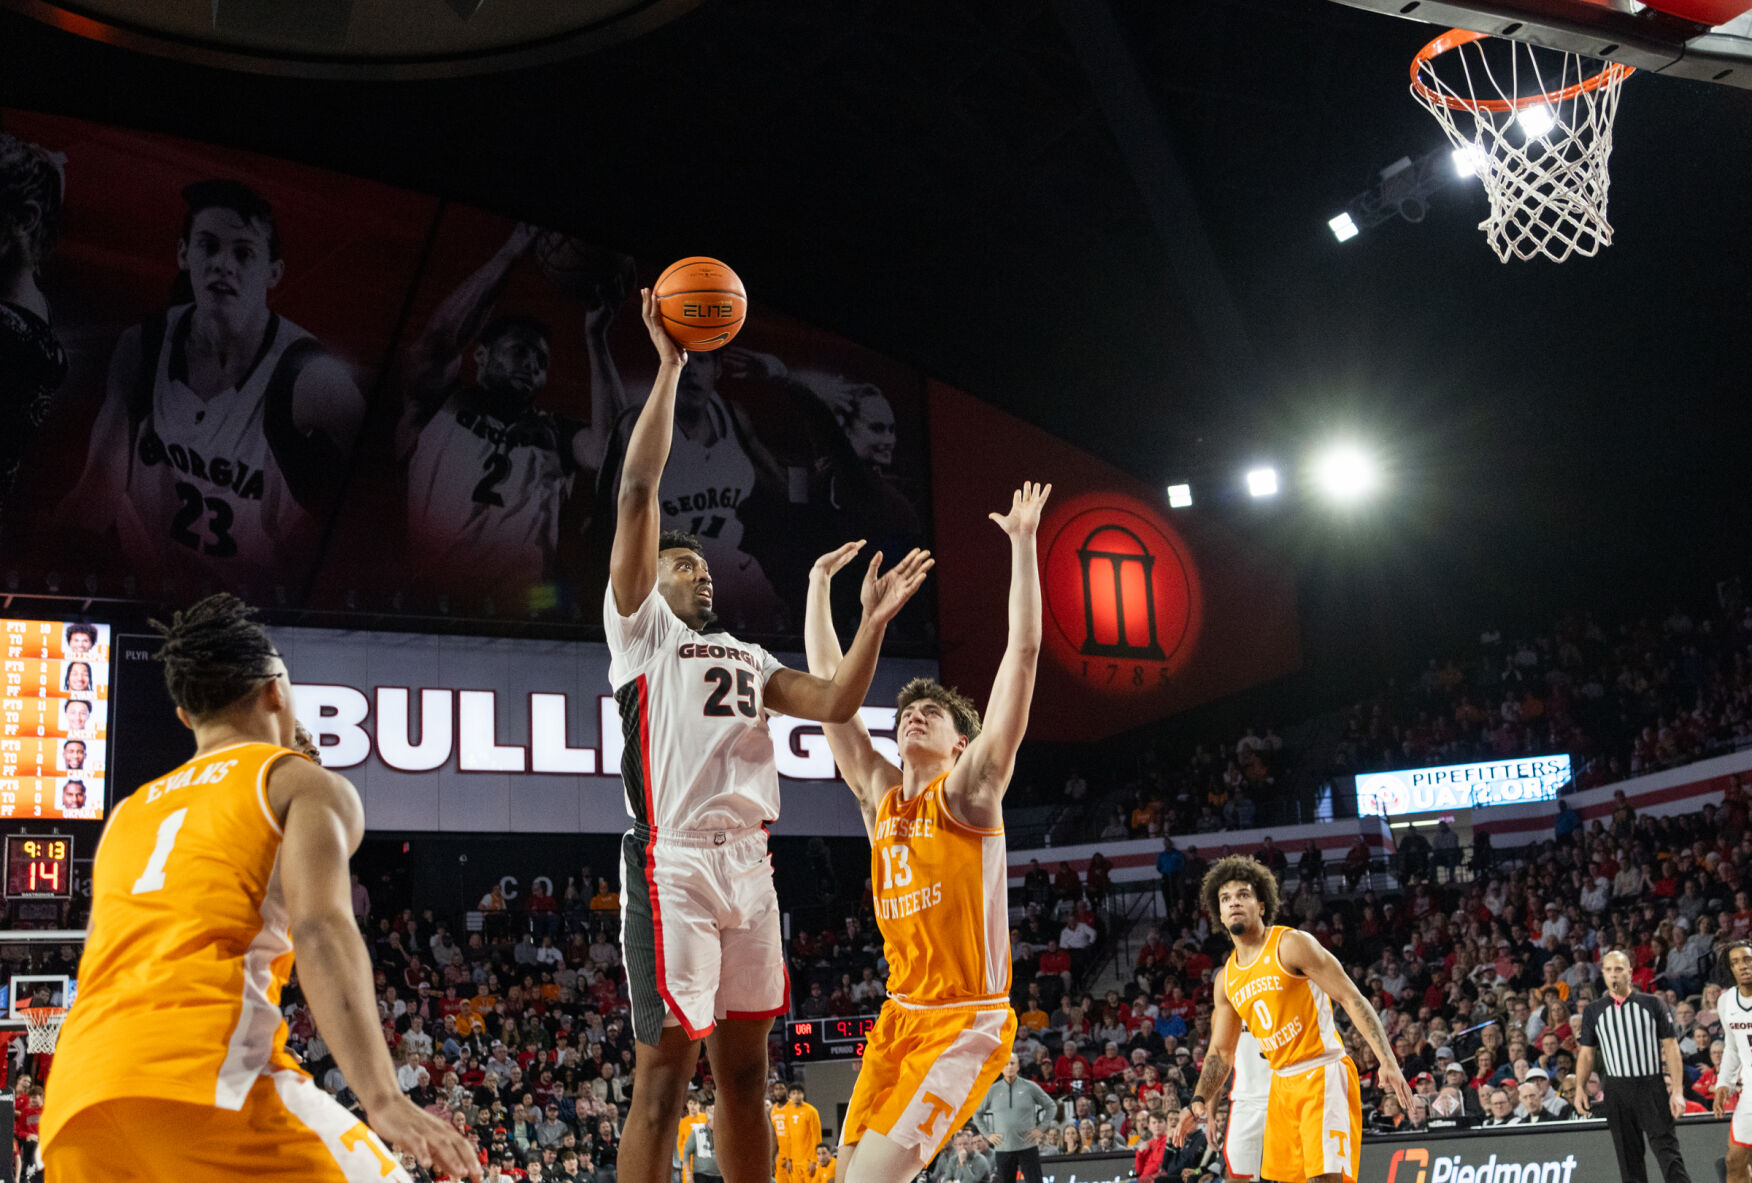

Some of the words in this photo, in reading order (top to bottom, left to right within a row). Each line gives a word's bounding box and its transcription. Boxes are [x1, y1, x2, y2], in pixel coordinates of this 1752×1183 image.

[683, 304, 732, 318] ELITE
[472, 452, 511, 507] 2
[662, 487, 742, 517] GEORGI
[170, 480, 238, 557] 23
[126, 649, 149, 660] PLYR
[679, 643, 761, 672] GEORGIA
[703, 666, 758, 718] 25
[145, 759, 239, 804] EVANS
[1412, 760, 1560, 787] PIPEFITTERS
[24, 841, 65, 860] 9:13
[131, 807, 189, 895] 1
[29, 862, 58, 891] 14
[882, 844, 912, 890] 13
[795, 1022, 812, 1035] UGA
[1252, 999, 1273, 1030] 0
[794, 1042, 811, 1056] 57
[830, 1045, 854, 1055] PERIOD
[856, 1042, 864, 1056] 2
[1431, 1154, 1577, 1183] Piedmont
